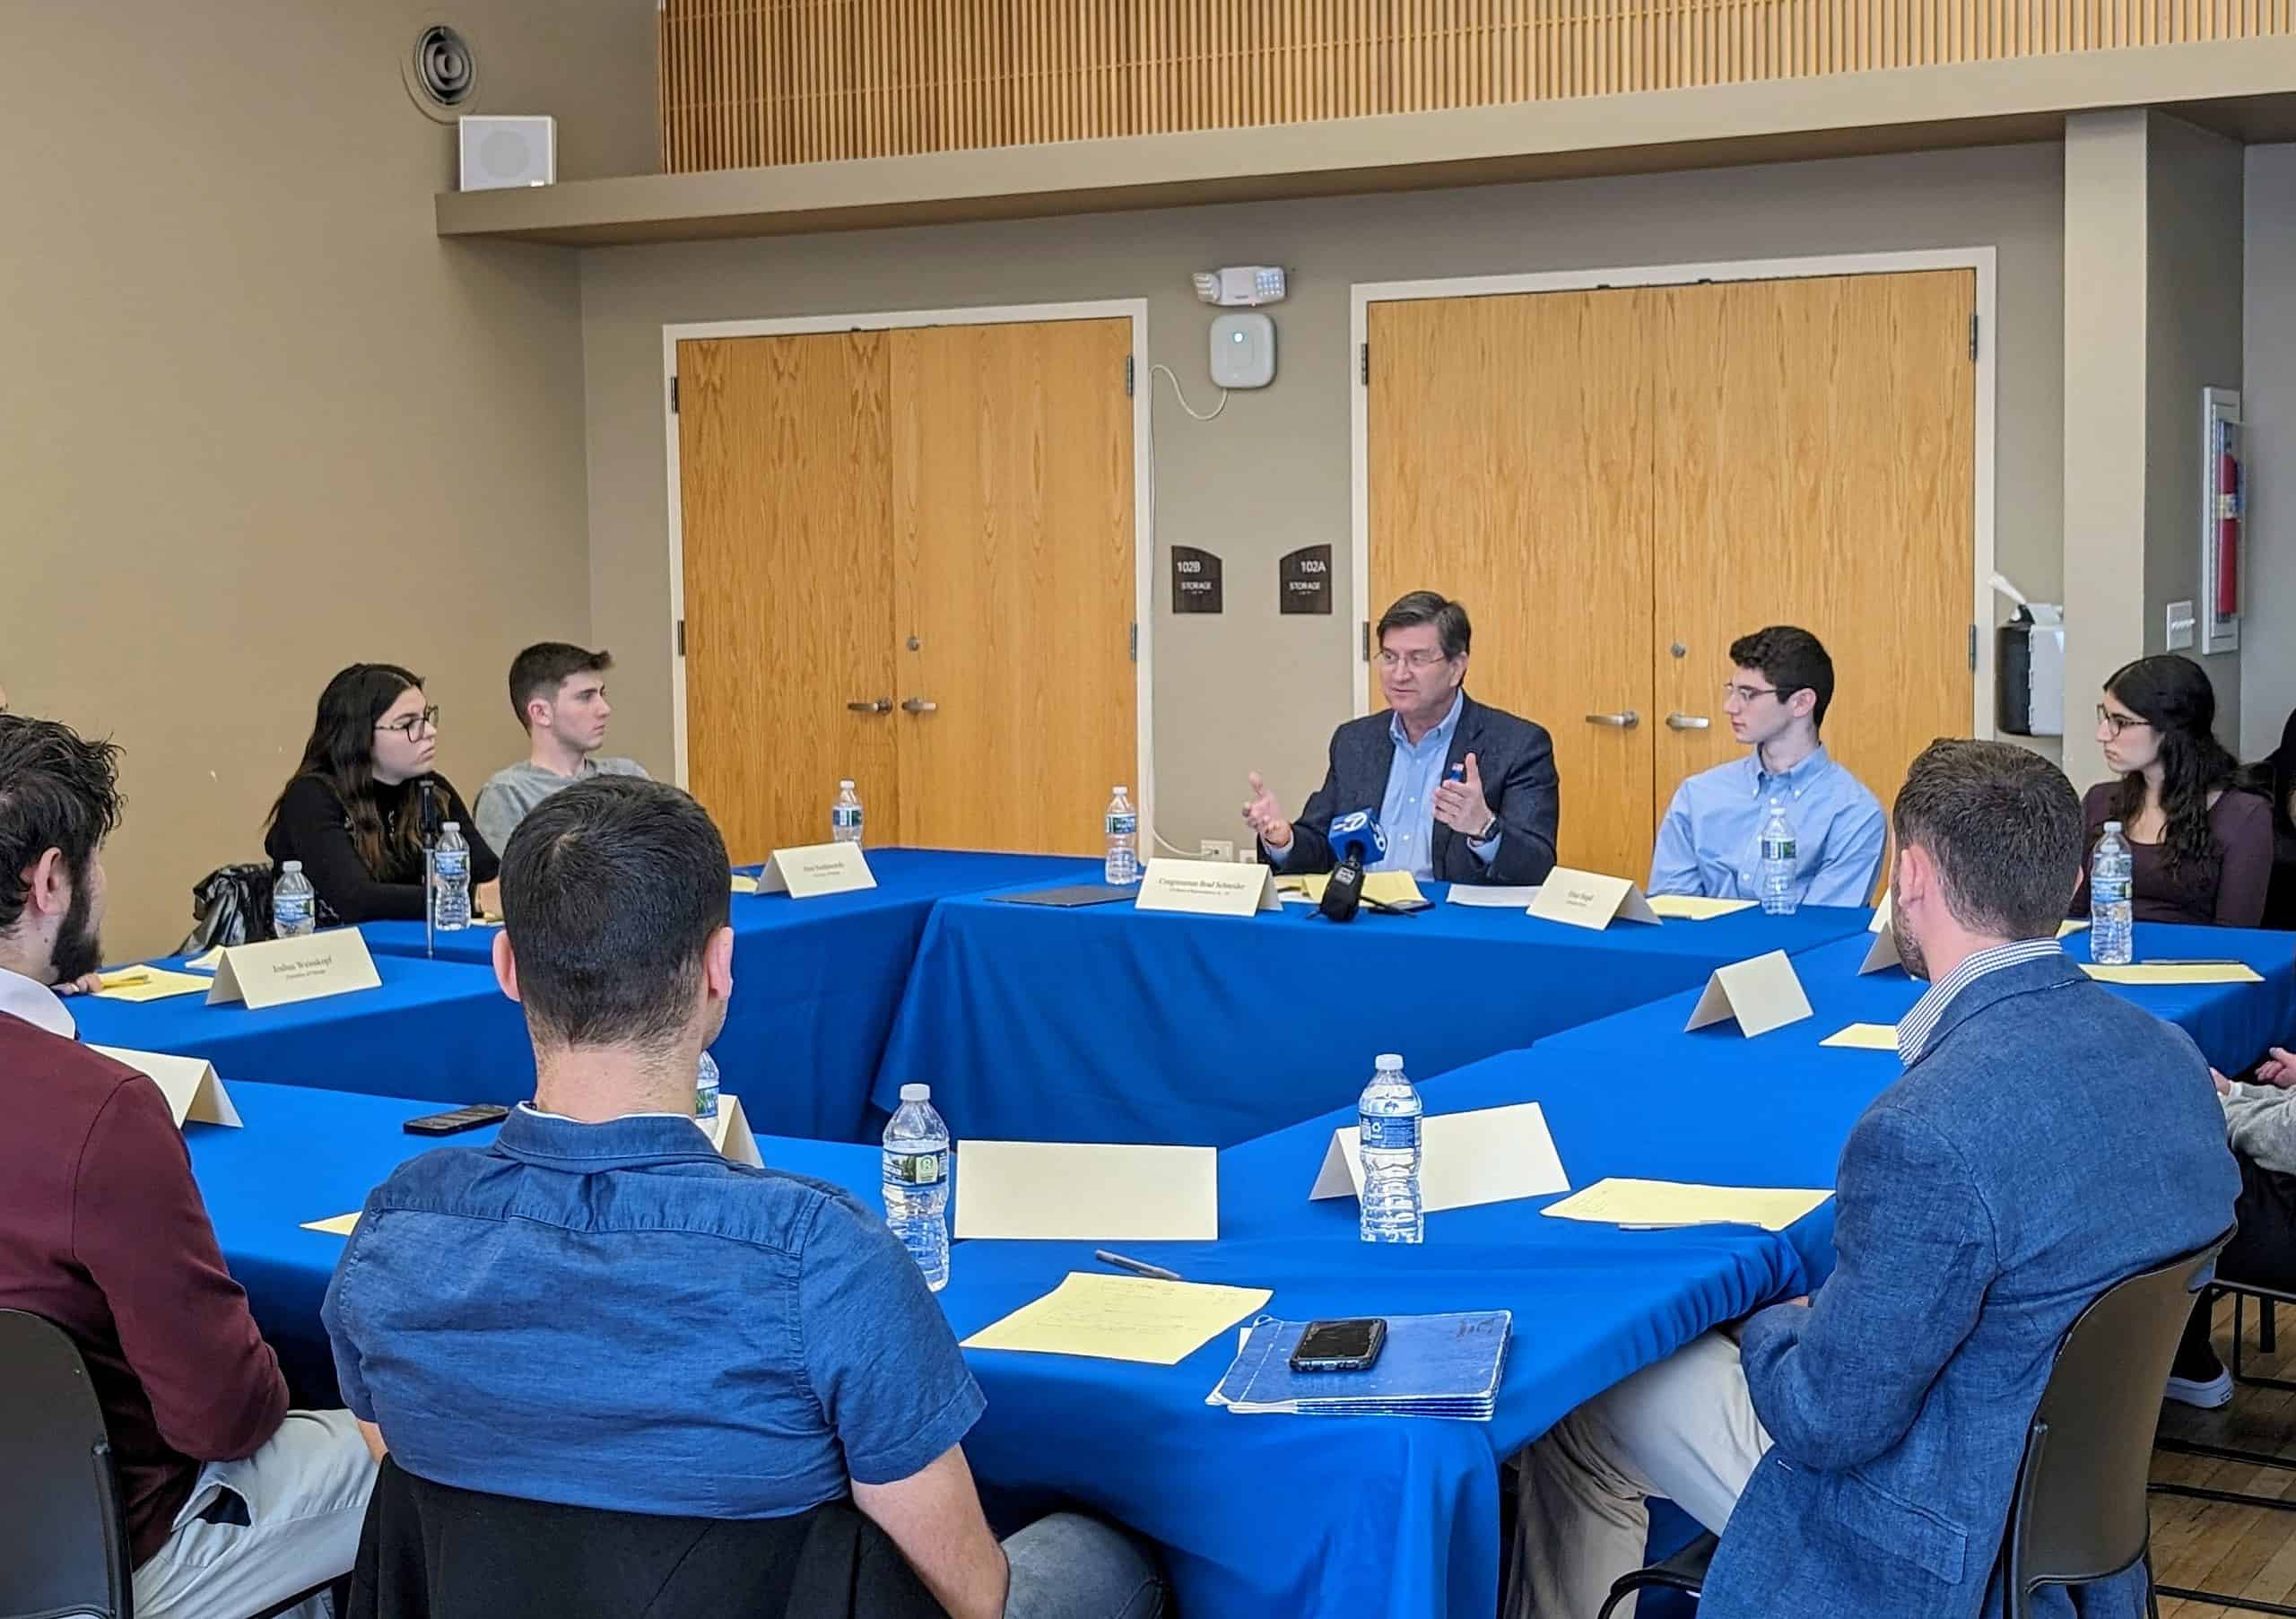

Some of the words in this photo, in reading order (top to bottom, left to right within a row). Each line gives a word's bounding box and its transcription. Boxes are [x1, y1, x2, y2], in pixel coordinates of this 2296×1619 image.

[1176, 561, 1201, 573] 102B
[1300, 561, 1326, 573] 102A
[1181, 581, 1212, 590] STORAGE
[1289, 581, 1320, 590] STORAGE
